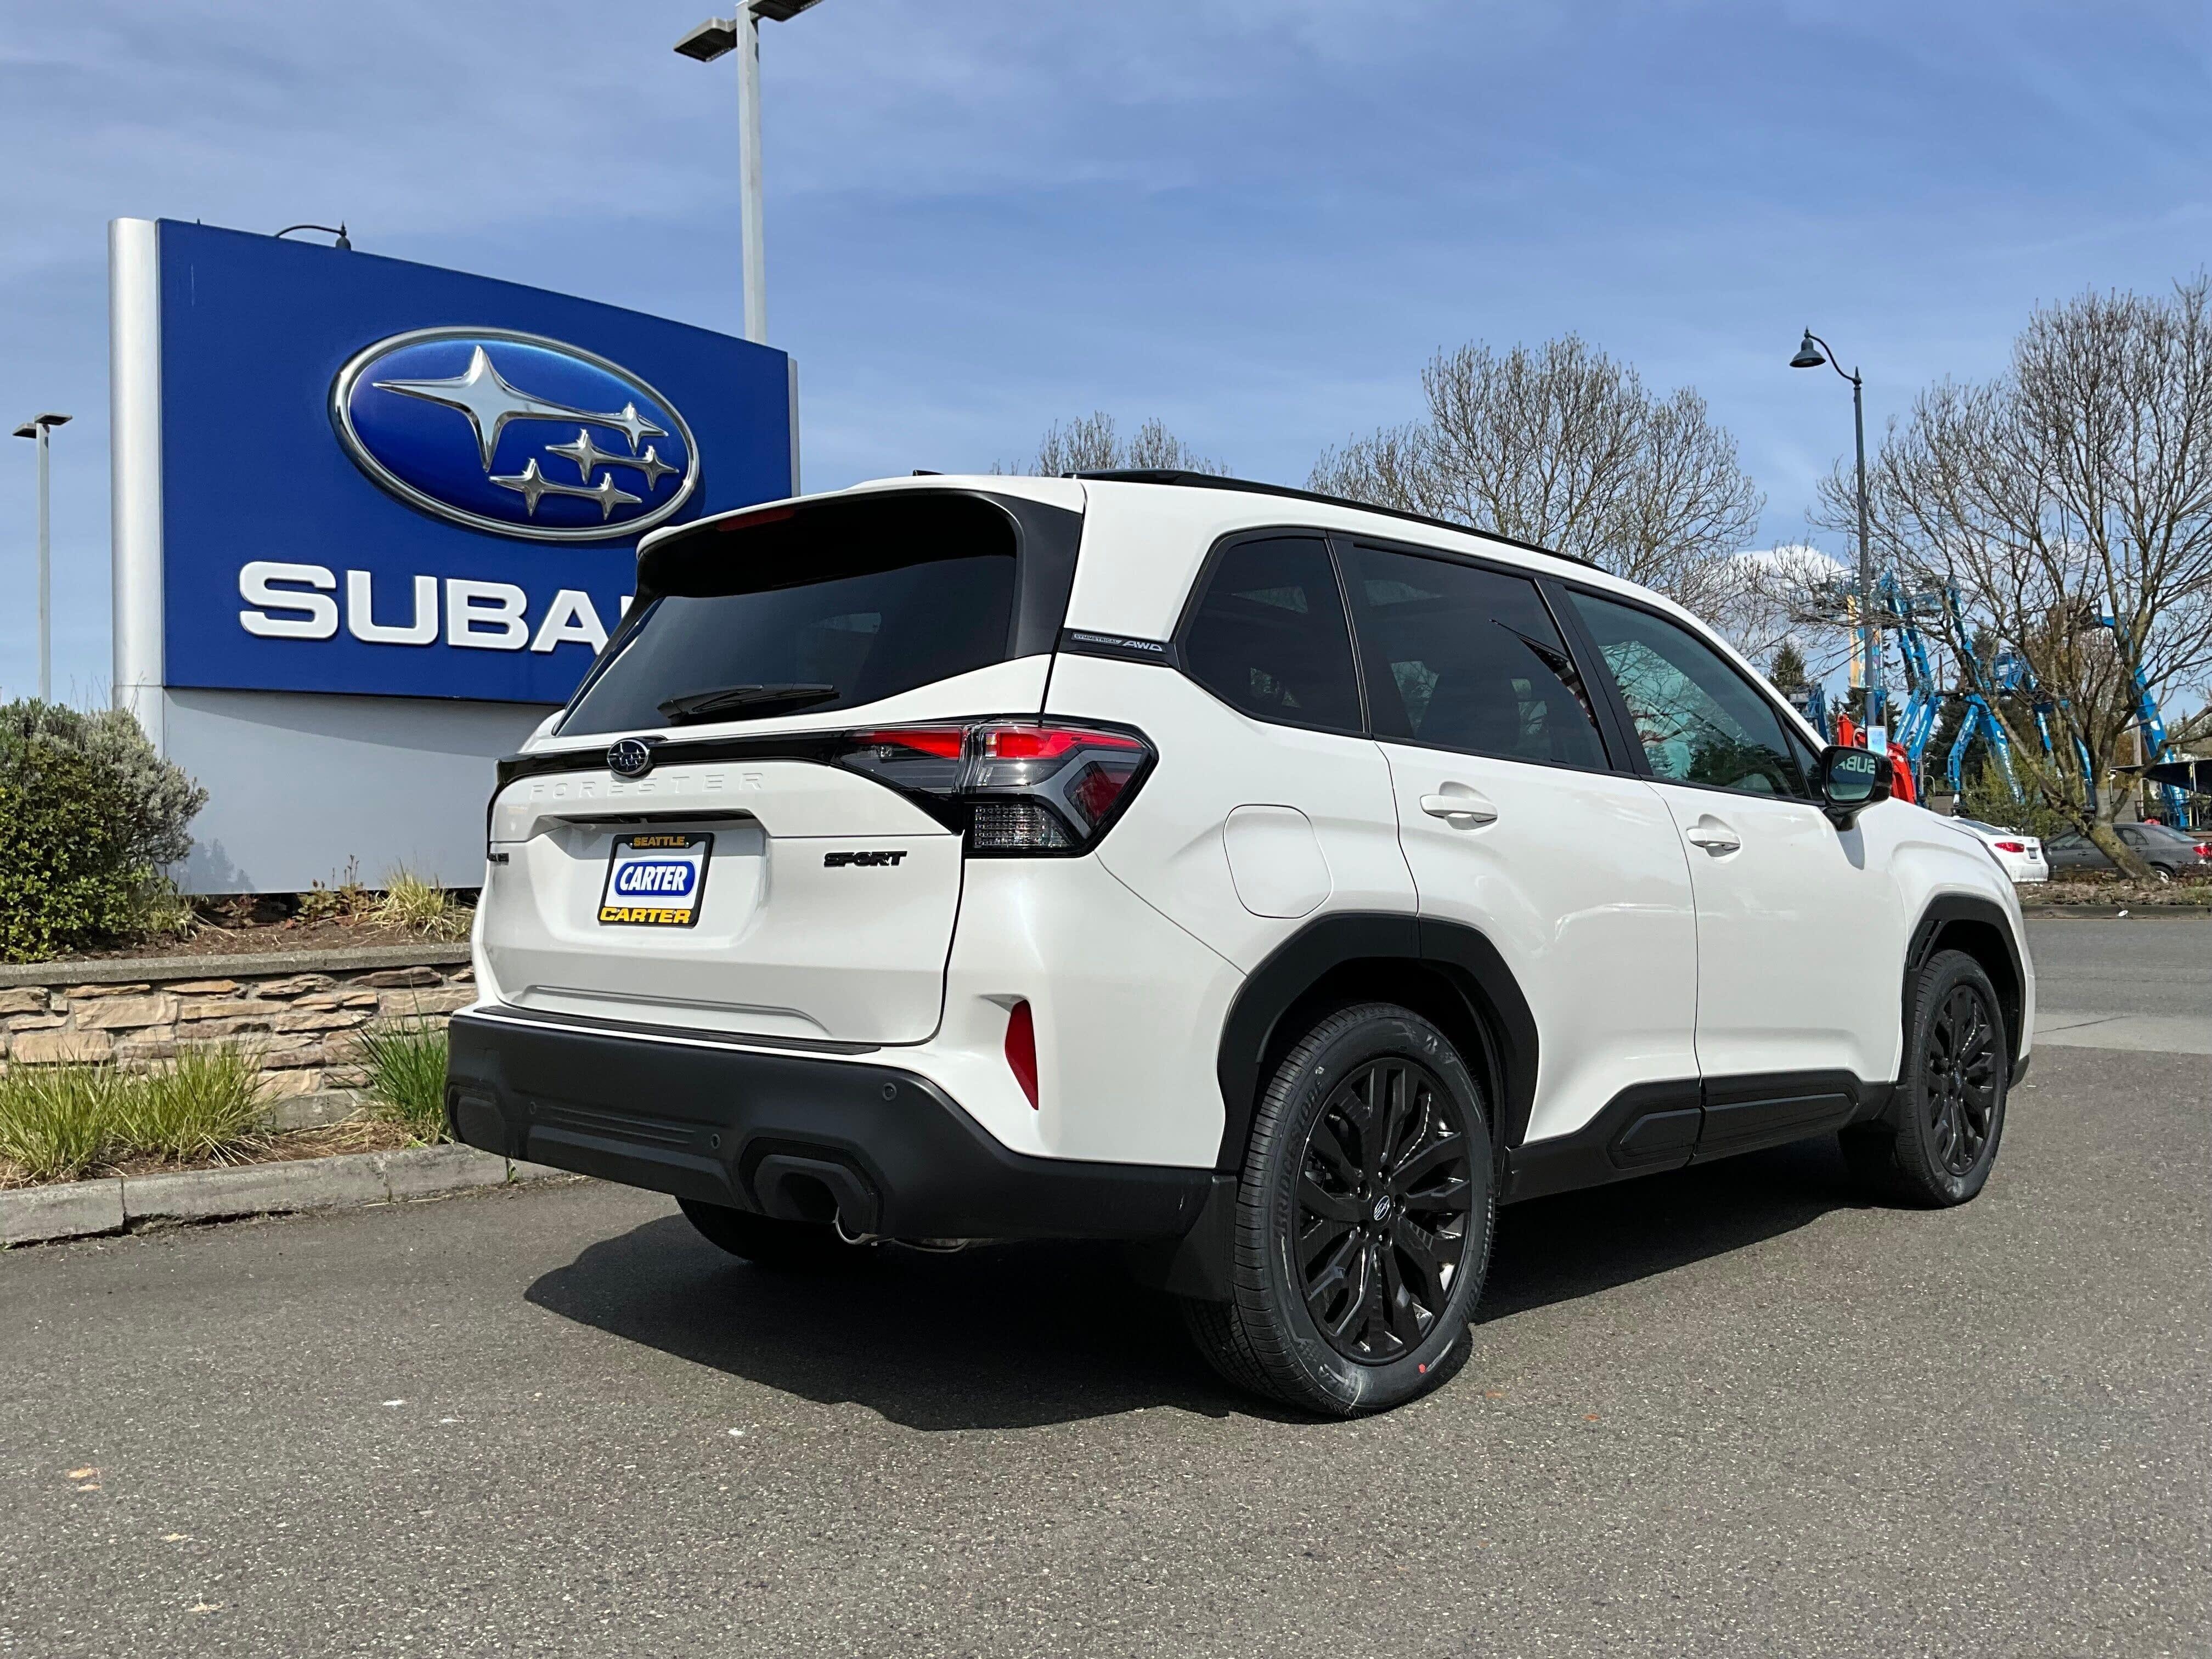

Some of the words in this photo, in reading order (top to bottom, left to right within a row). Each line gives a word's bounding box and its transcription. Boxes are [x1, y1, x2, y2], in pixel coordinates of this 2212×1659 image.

[240, 561, 634, 656] SUBA
[1075, 634, 1119, 644] SYMMETRICAL
[1122, 640, 1163, 652] AWD
[529, 772, 764, 800] FORESTER
[634, 836, 685, 847] SEATTLE
[823, 851, 907, 867] SPORT
[620, 866, 687, 891] CARTER
[600, 907, 691, 923] CARTER
